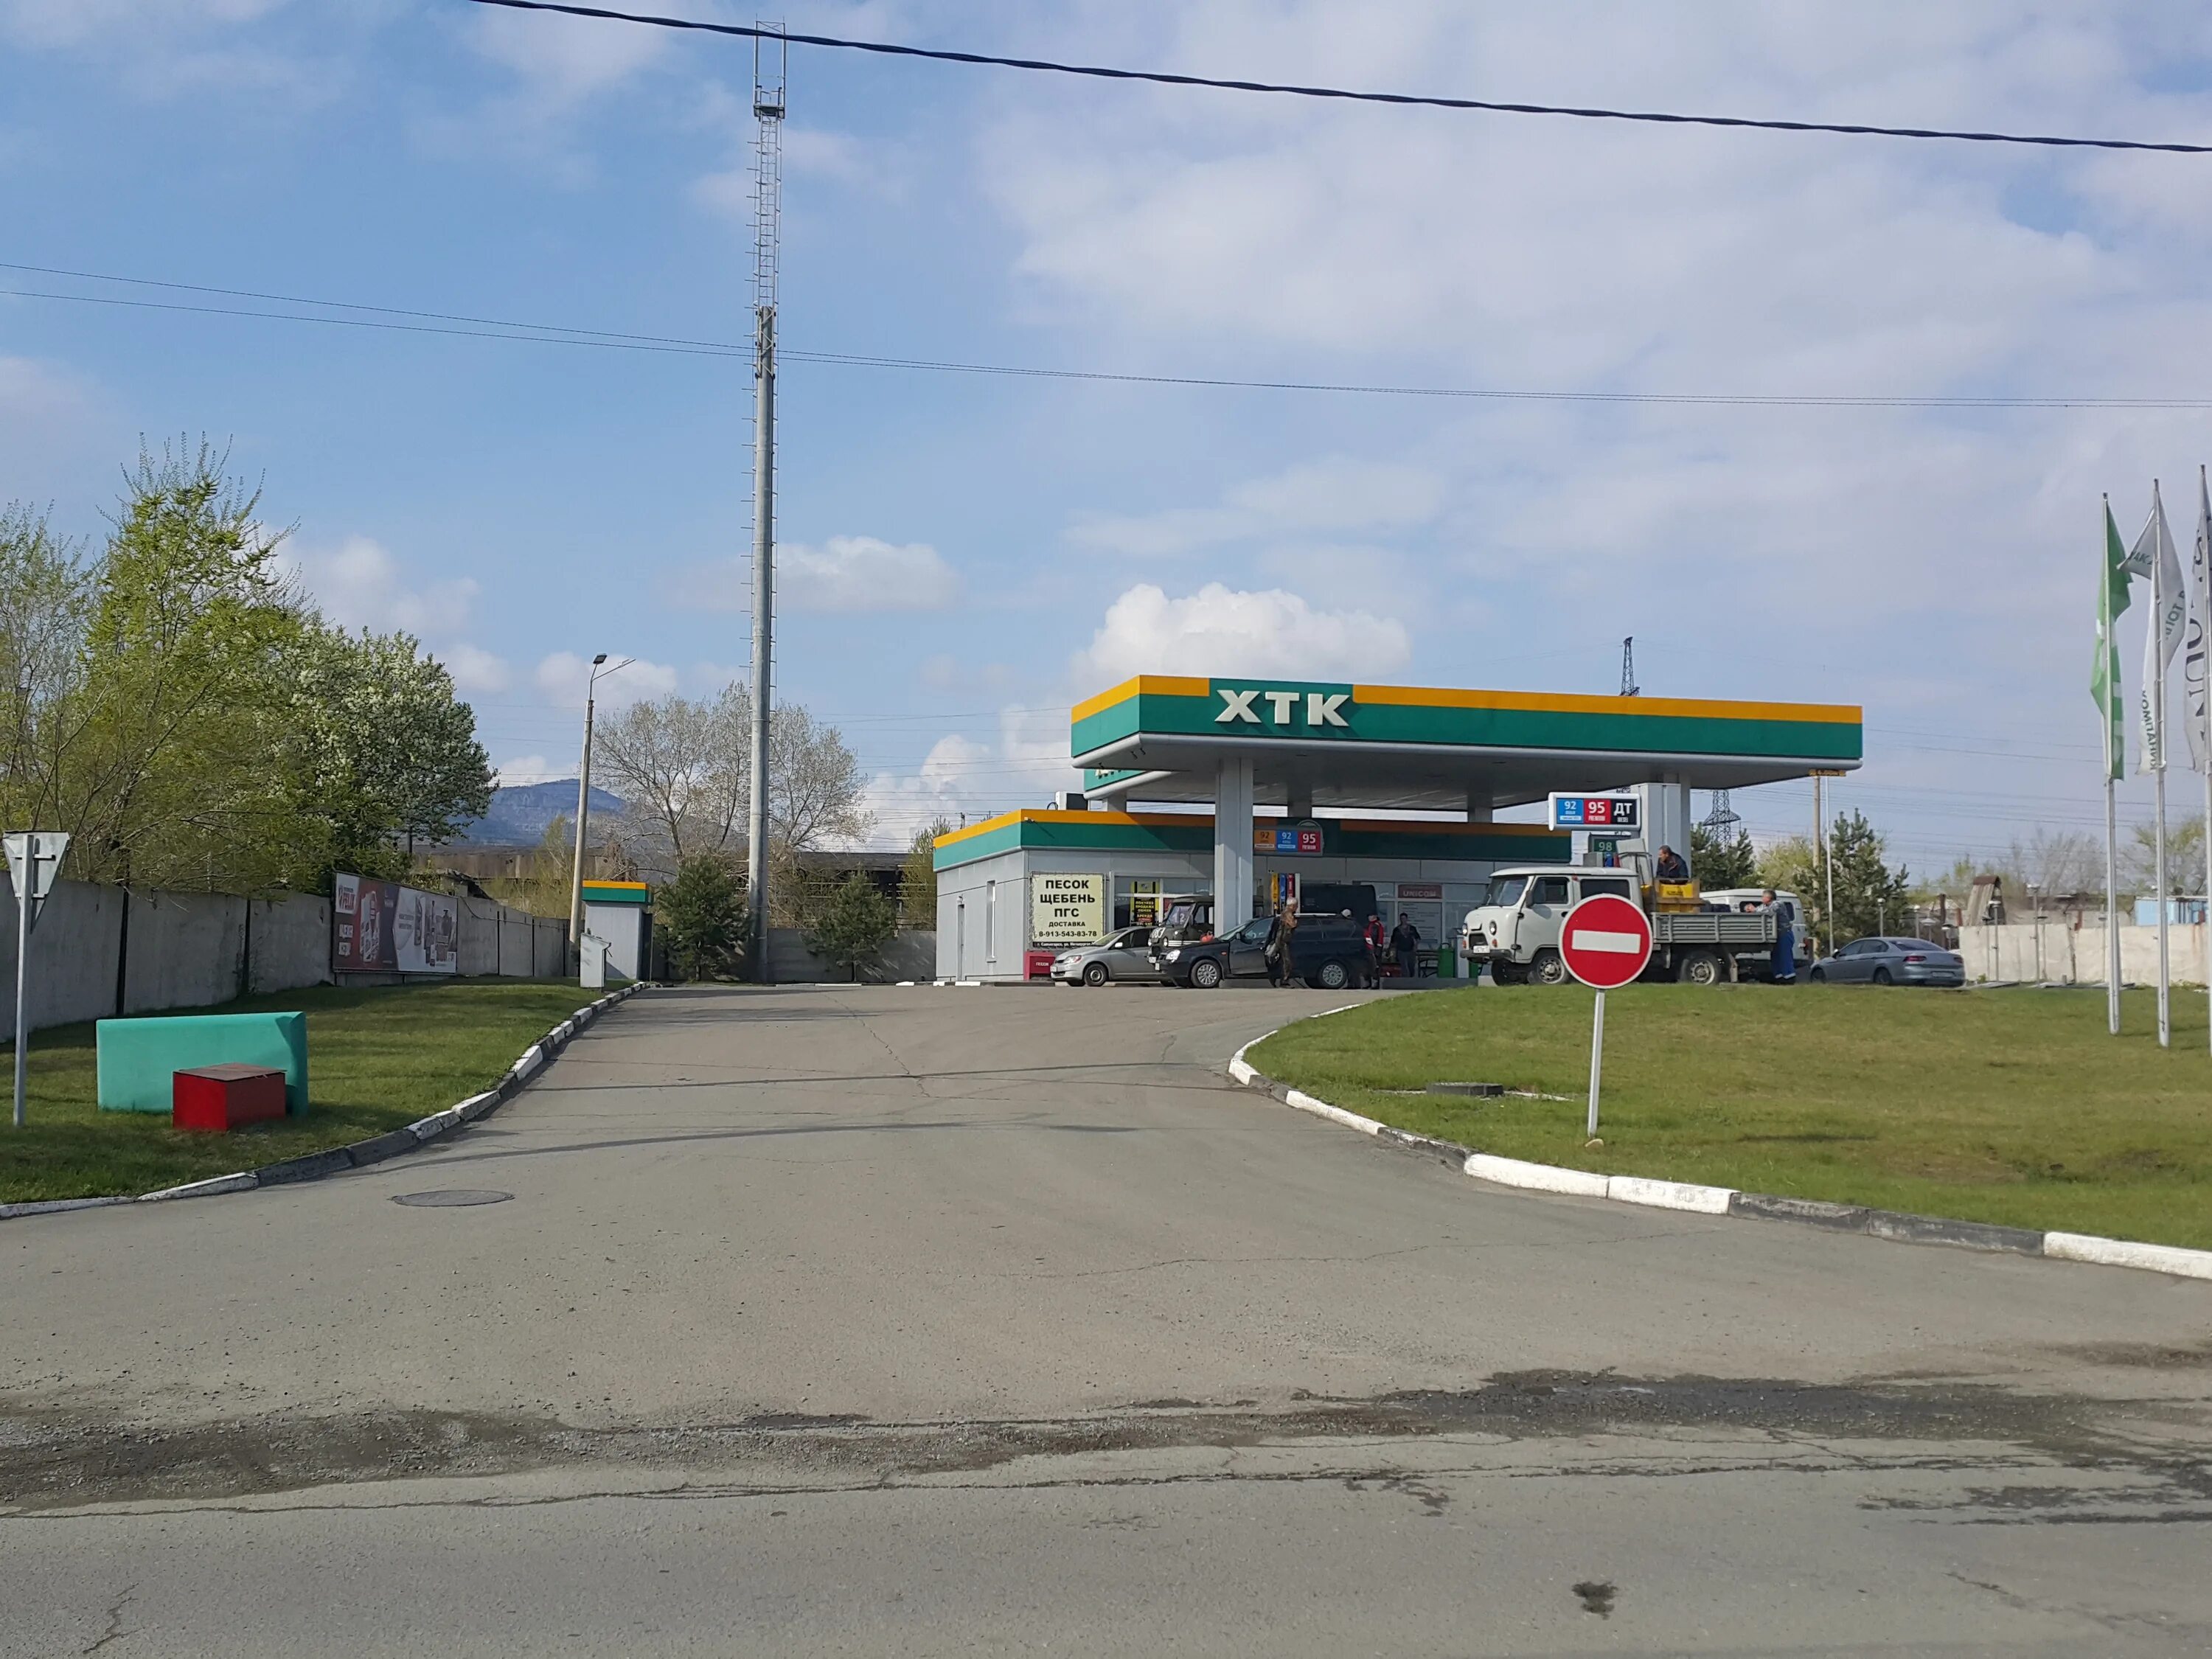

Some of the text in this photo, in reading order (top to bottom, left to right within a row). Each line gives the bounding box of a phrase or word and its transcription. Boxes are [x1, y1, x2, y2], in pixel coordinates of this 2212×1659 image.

[1214, 689, 1351, 727] ХТК
[1564, 801, 1576, 810] 92
[1588, 801, 1605, 814] 95
[1613, 802, 1632, 816] ДТ
[1260, 831, 1270, 839] 92
[1281, 832, 1292, 840] 92
[1302, 833, 1316, 844] 95
[1599, 841, 1613, 851] 98
[1046, 880, 1089, 889] ПЕСОК
[1040, 894, 1096, 905] ЩЕБЕНЬ
[1054, 908, 1079, 917] ПГС
